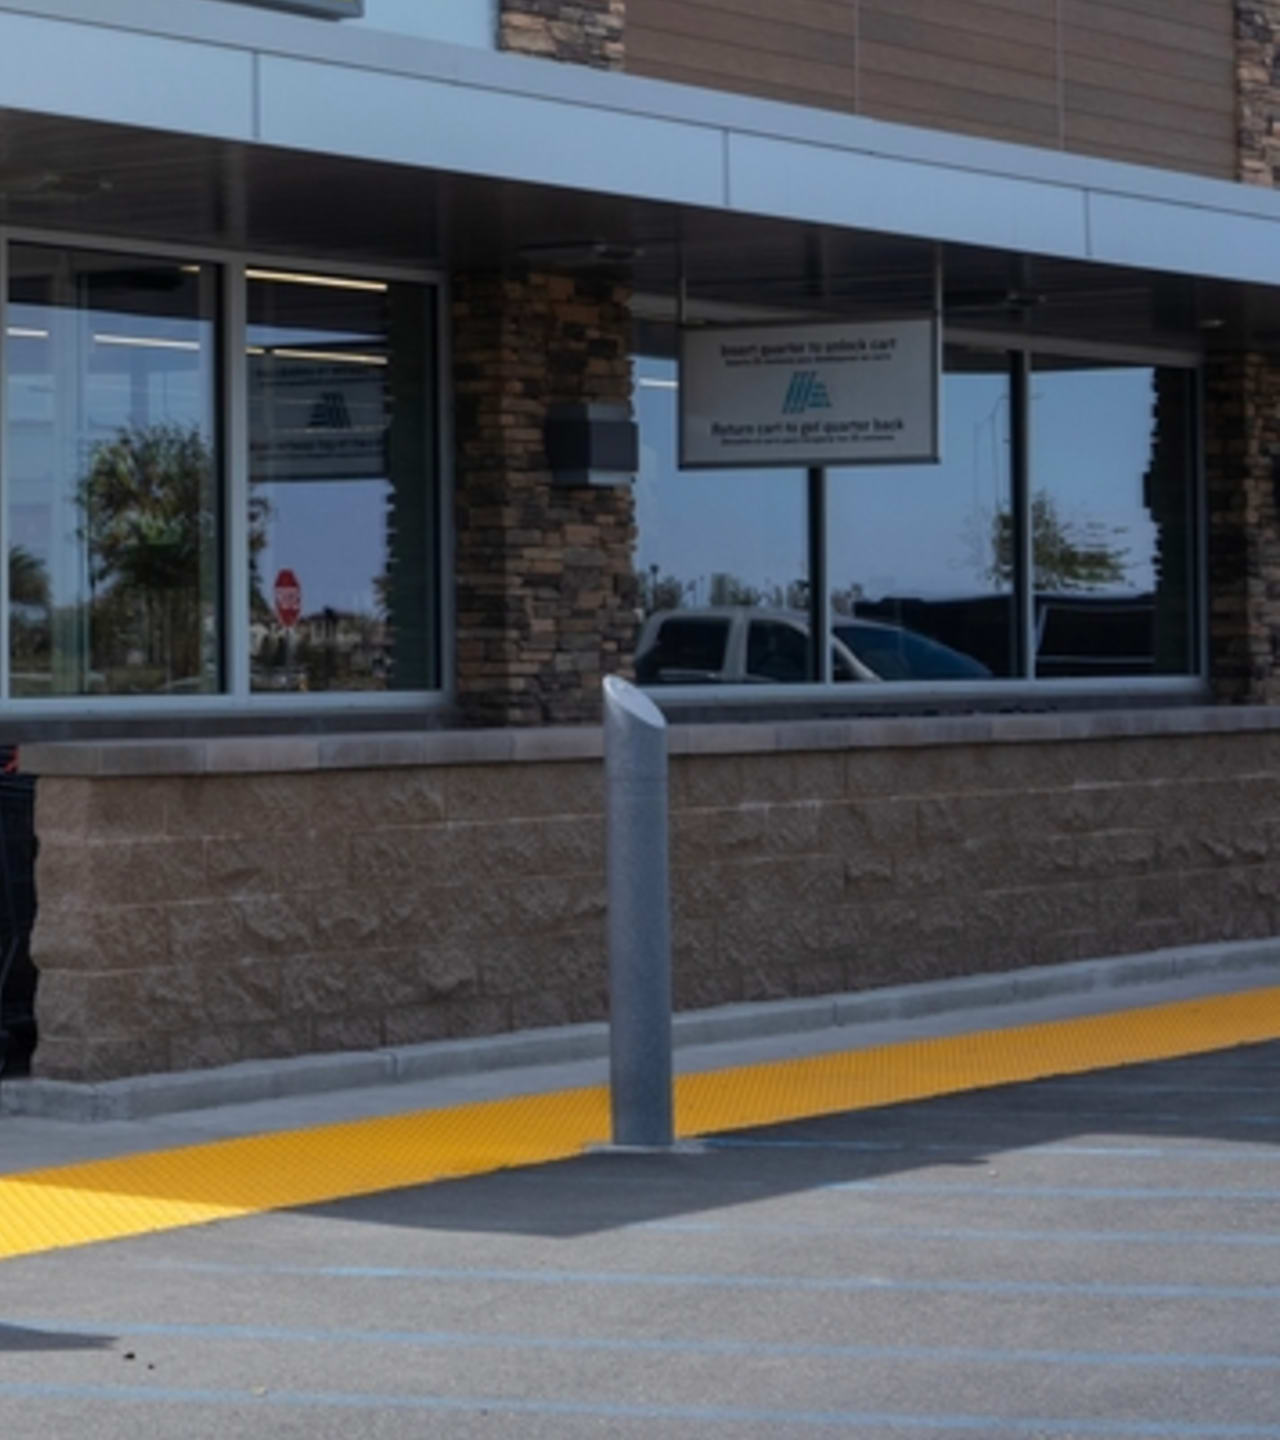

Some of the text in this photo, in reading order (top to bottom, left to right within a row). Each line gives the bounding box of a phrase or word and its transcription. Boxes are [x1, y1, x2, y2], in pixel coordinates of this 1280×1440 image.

[761, 342, 804, 358] quarter
[808, 340, 822, 353] to
[869, 337, 896, 350] cart
[711, 416, 904, 439] Return cart to get quarter back
